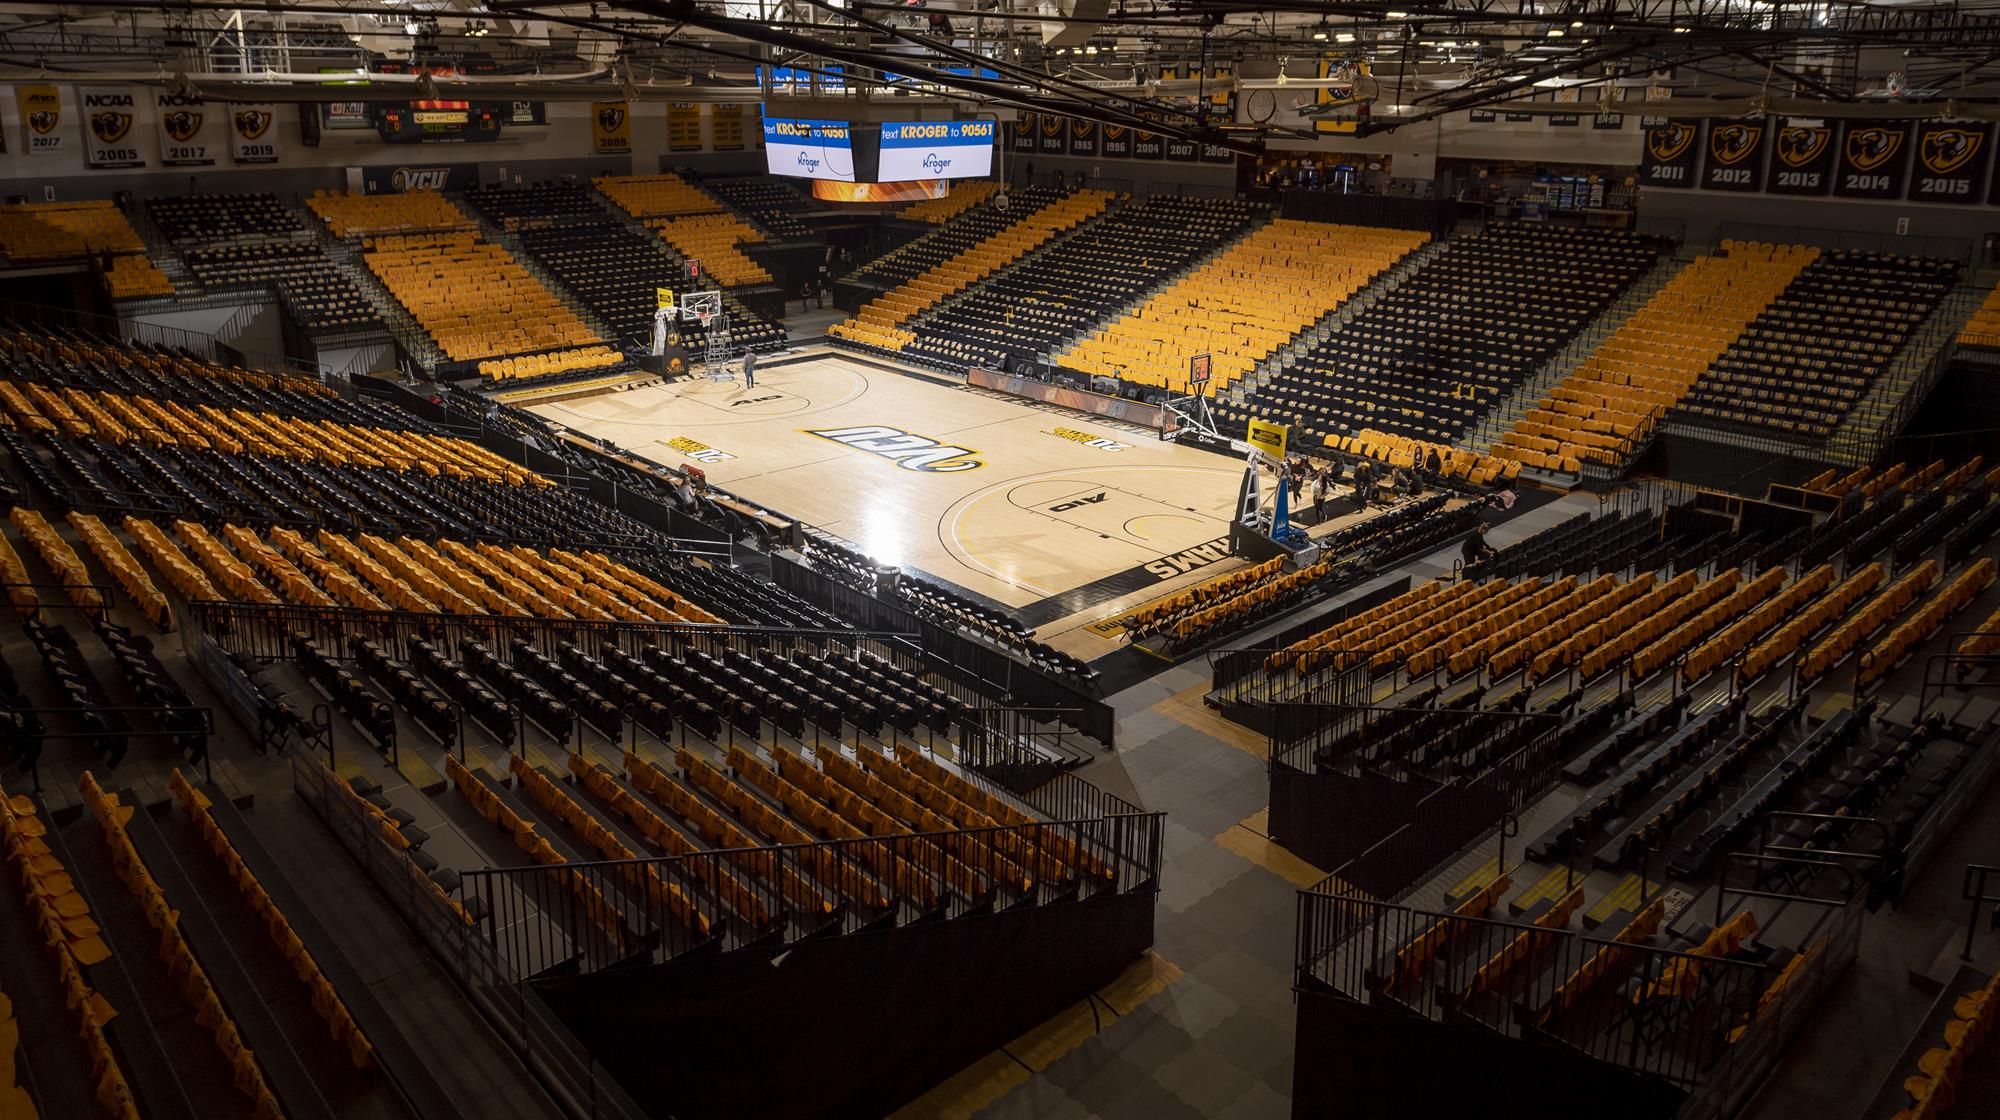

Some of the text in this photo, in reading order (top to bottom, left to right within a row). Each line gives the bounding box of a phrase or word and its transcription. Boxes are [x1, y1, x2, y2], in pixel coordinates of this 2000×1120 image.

[85, 95, 134, 107] NCAA
[882, 123, 993, 139] text KROGER to 90561
[32, 138, 60, 147] 2017
[600, 138, 627, 147] 2009
[1074, 139, 1093, 150] 1985
[1106, 142, 1126, 152] 1996
[1136, 143, 1159, 154] 2004
[97, 149, 138, 161] 2005
[170, 147, 206, 159] 2017
[242, 145, 273, 156] 2019
[1170, 145, 1193, 156] 2007
[797, 151, 820, 173] Kroger
[922, 153, 951, 174] Kroger
[1651, 165, 1685, 180] 2011
[1711, 168, 1752, 184] 2012
[1777, 171, 1821, 187] 2013
[393, 168, 450, 192] VCU
[1845, 174, 1890, 191] 2014
[1919, 177, 1971, 195] 2015
[802, 425, 986, 472] VCU
